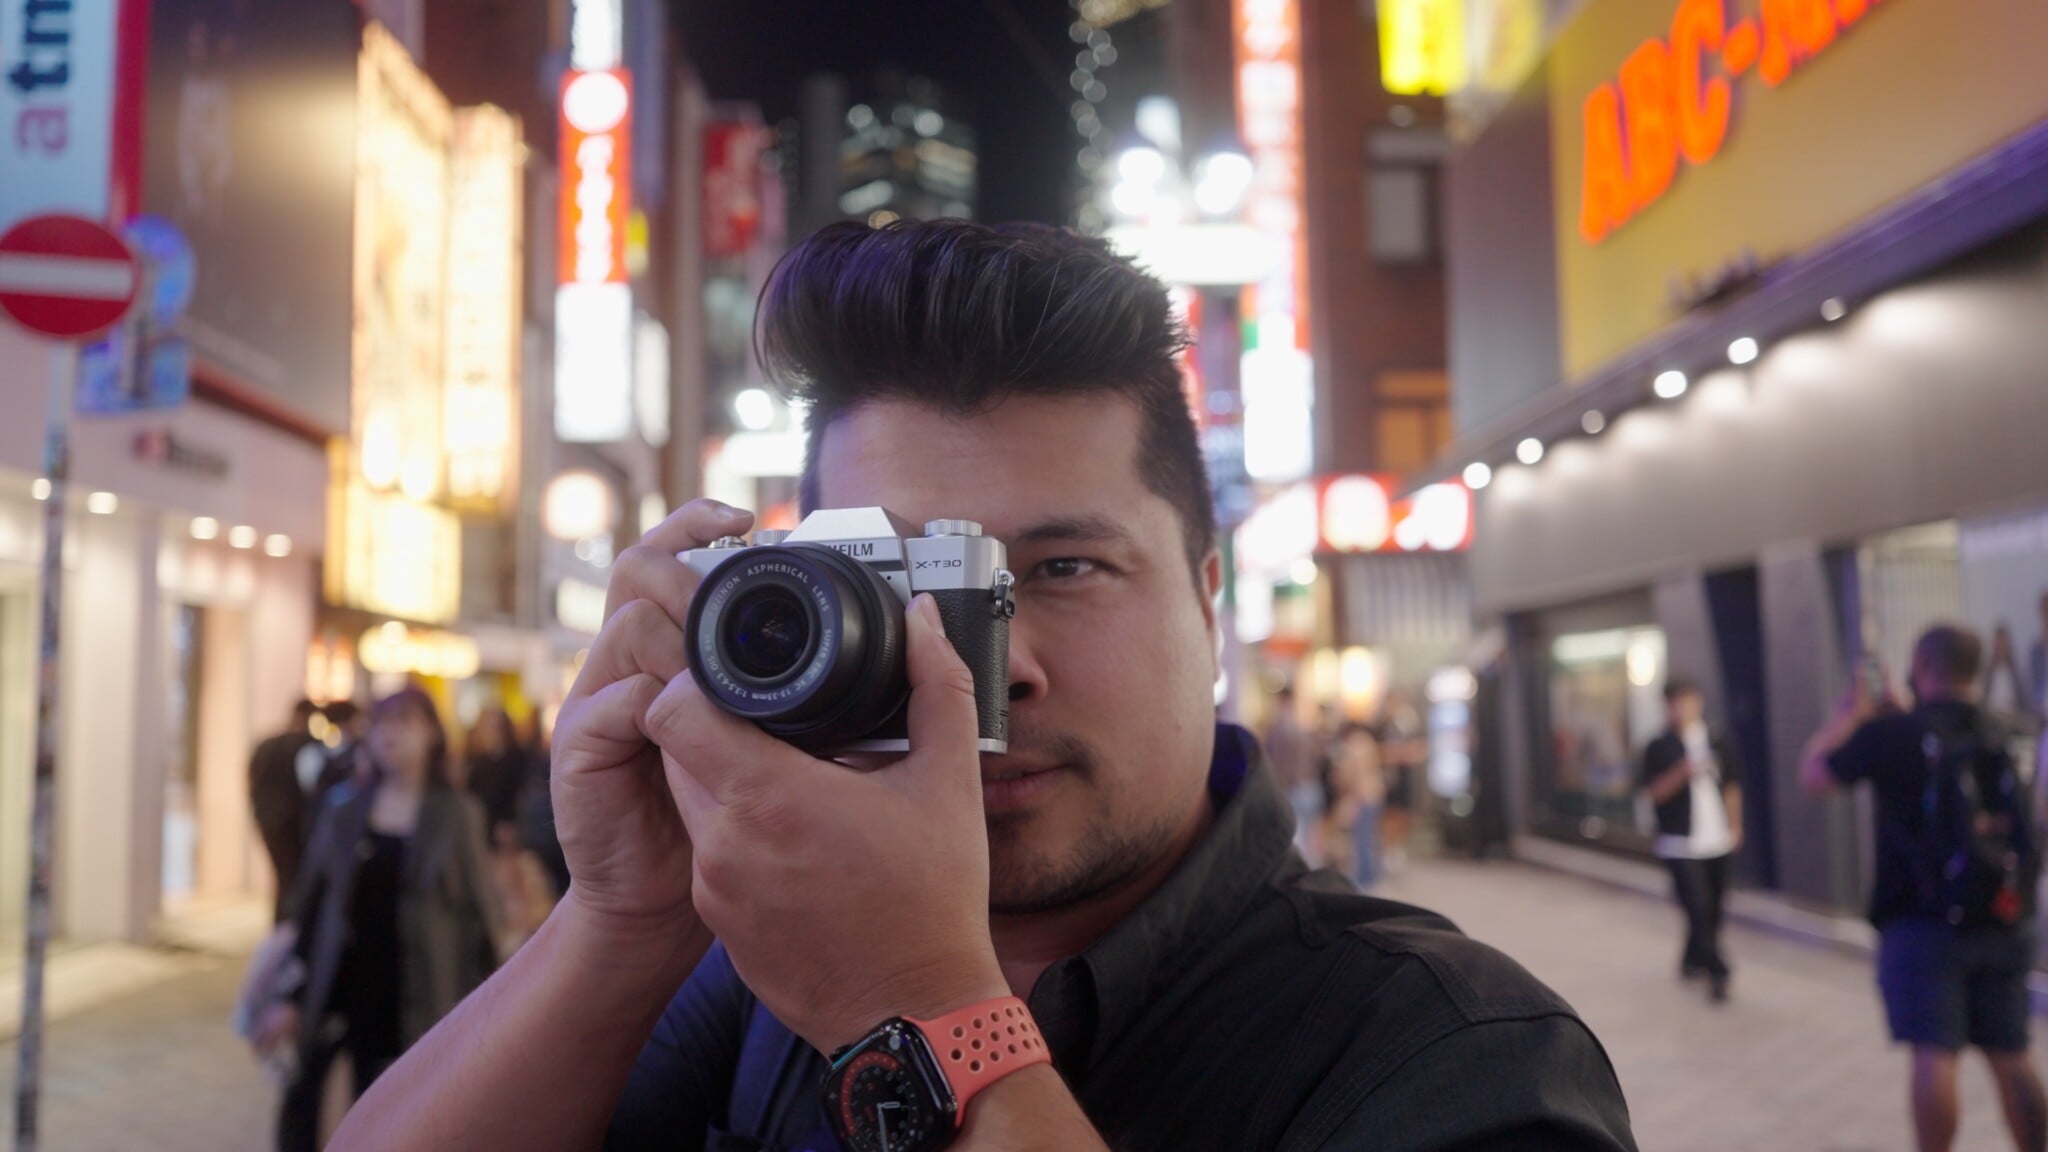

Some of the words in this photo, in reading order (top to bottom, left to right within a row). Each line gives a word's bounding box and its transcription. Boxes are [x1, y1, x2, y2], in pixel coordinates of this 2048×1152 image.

[916, 559, 962, 569] X-T30
[747, 564, 808, 584] ASPHERICAL
[812, 585, 830, 612] LENS
[821, 628, 833, 659] SUPER
